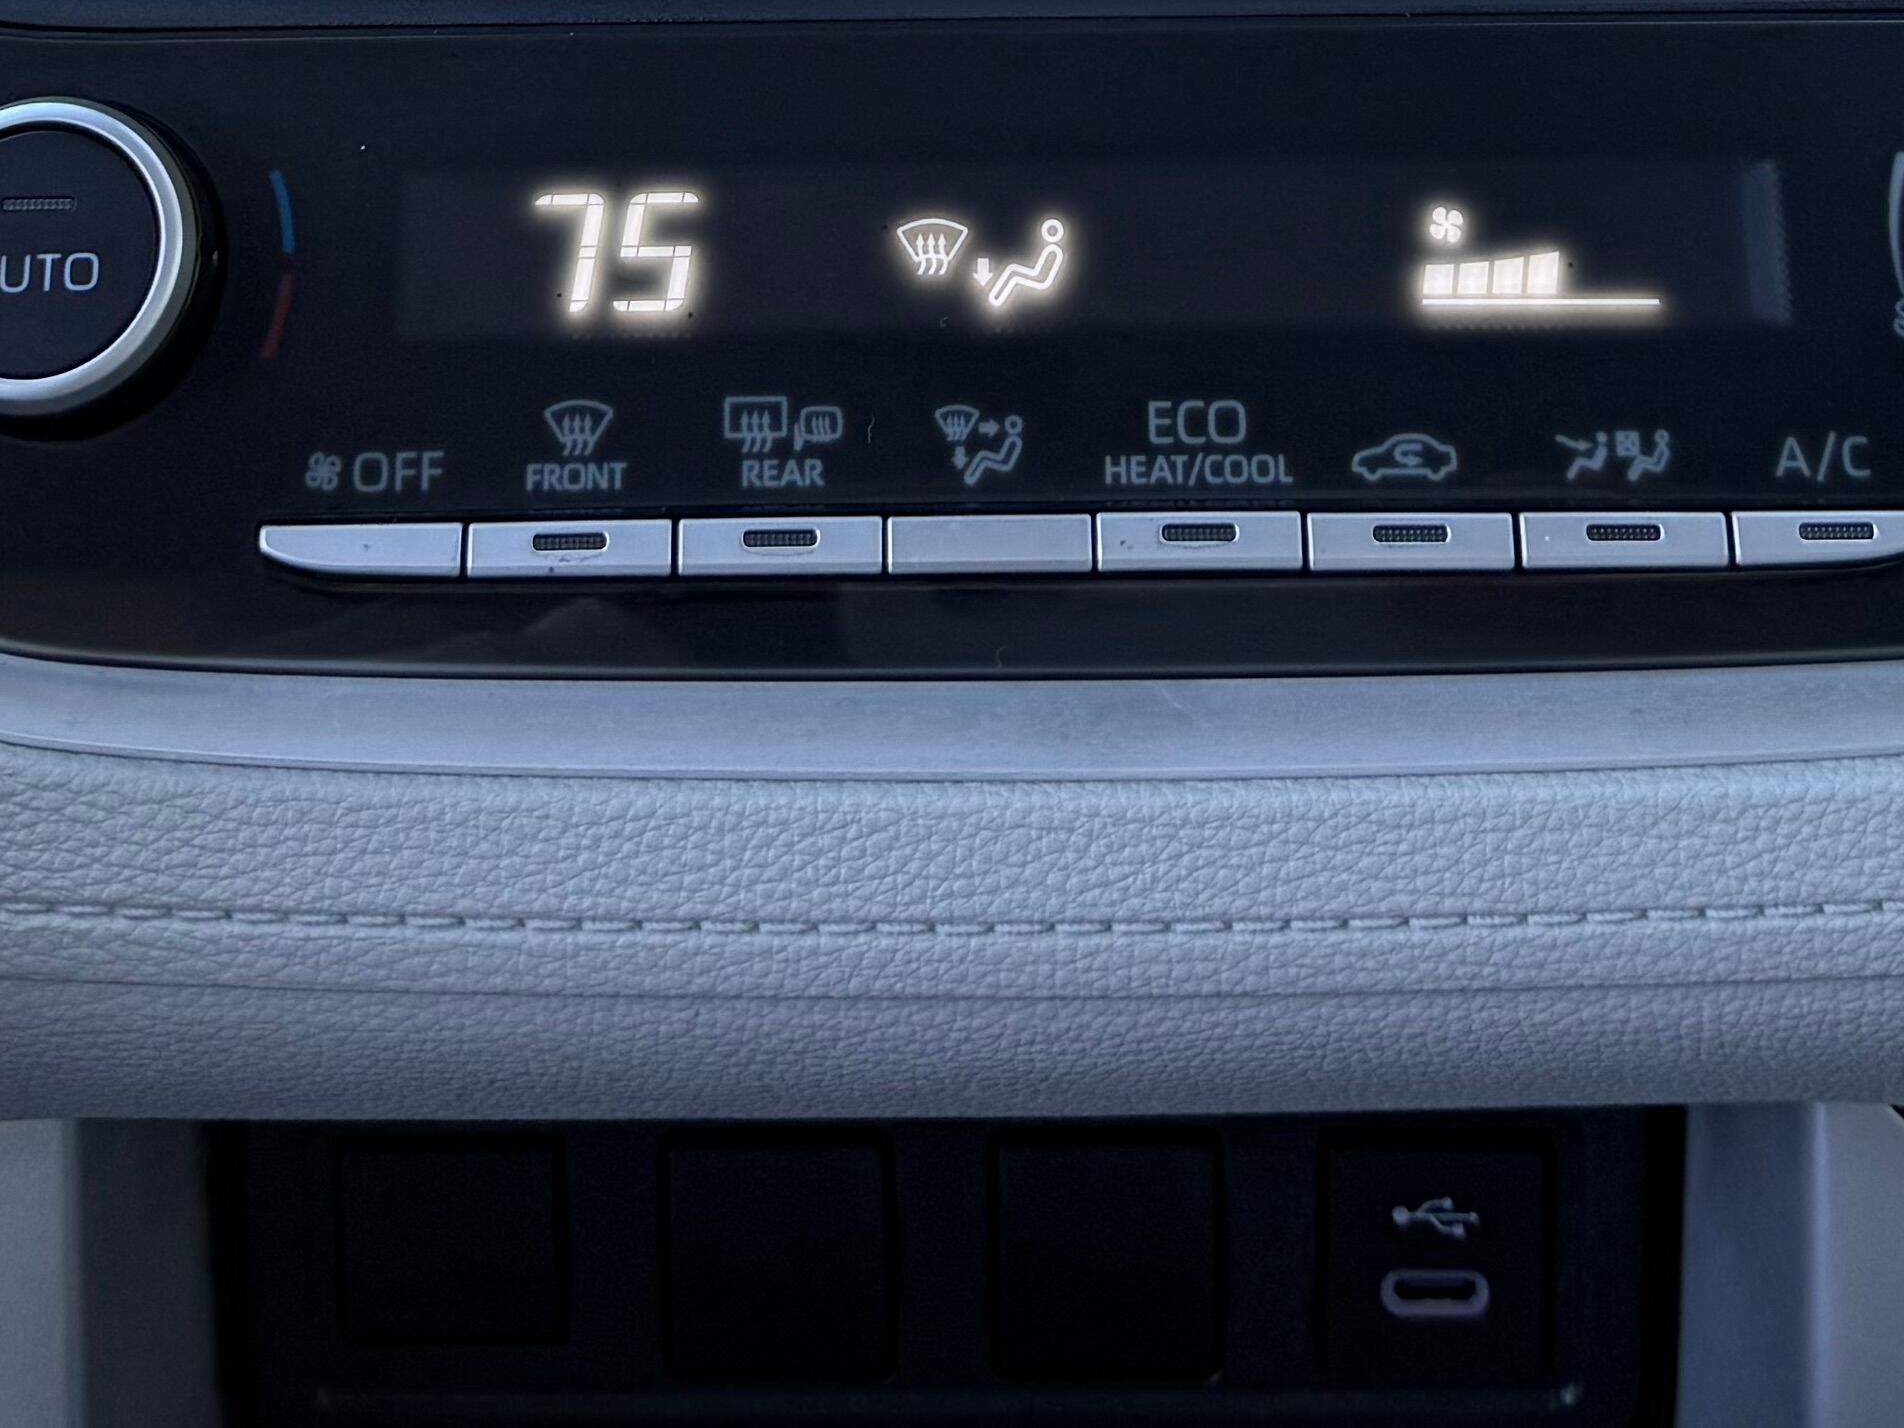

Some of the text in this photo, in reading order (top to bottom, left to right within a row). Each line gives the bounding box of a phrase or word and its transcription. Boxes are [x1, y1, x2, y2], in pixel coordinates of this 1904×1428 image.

[533, 191, 701, 313] 75
[1149, 400, 1247, 445] ECO
[353, 451, 445, 493] OFF
[526, 462, 627, 492] FRONT
[742, 459, 824, 488] REAR
[1104, 453, 1294, 486] HEAT/COOL
[1776, 432, 1871, 481] A/C
